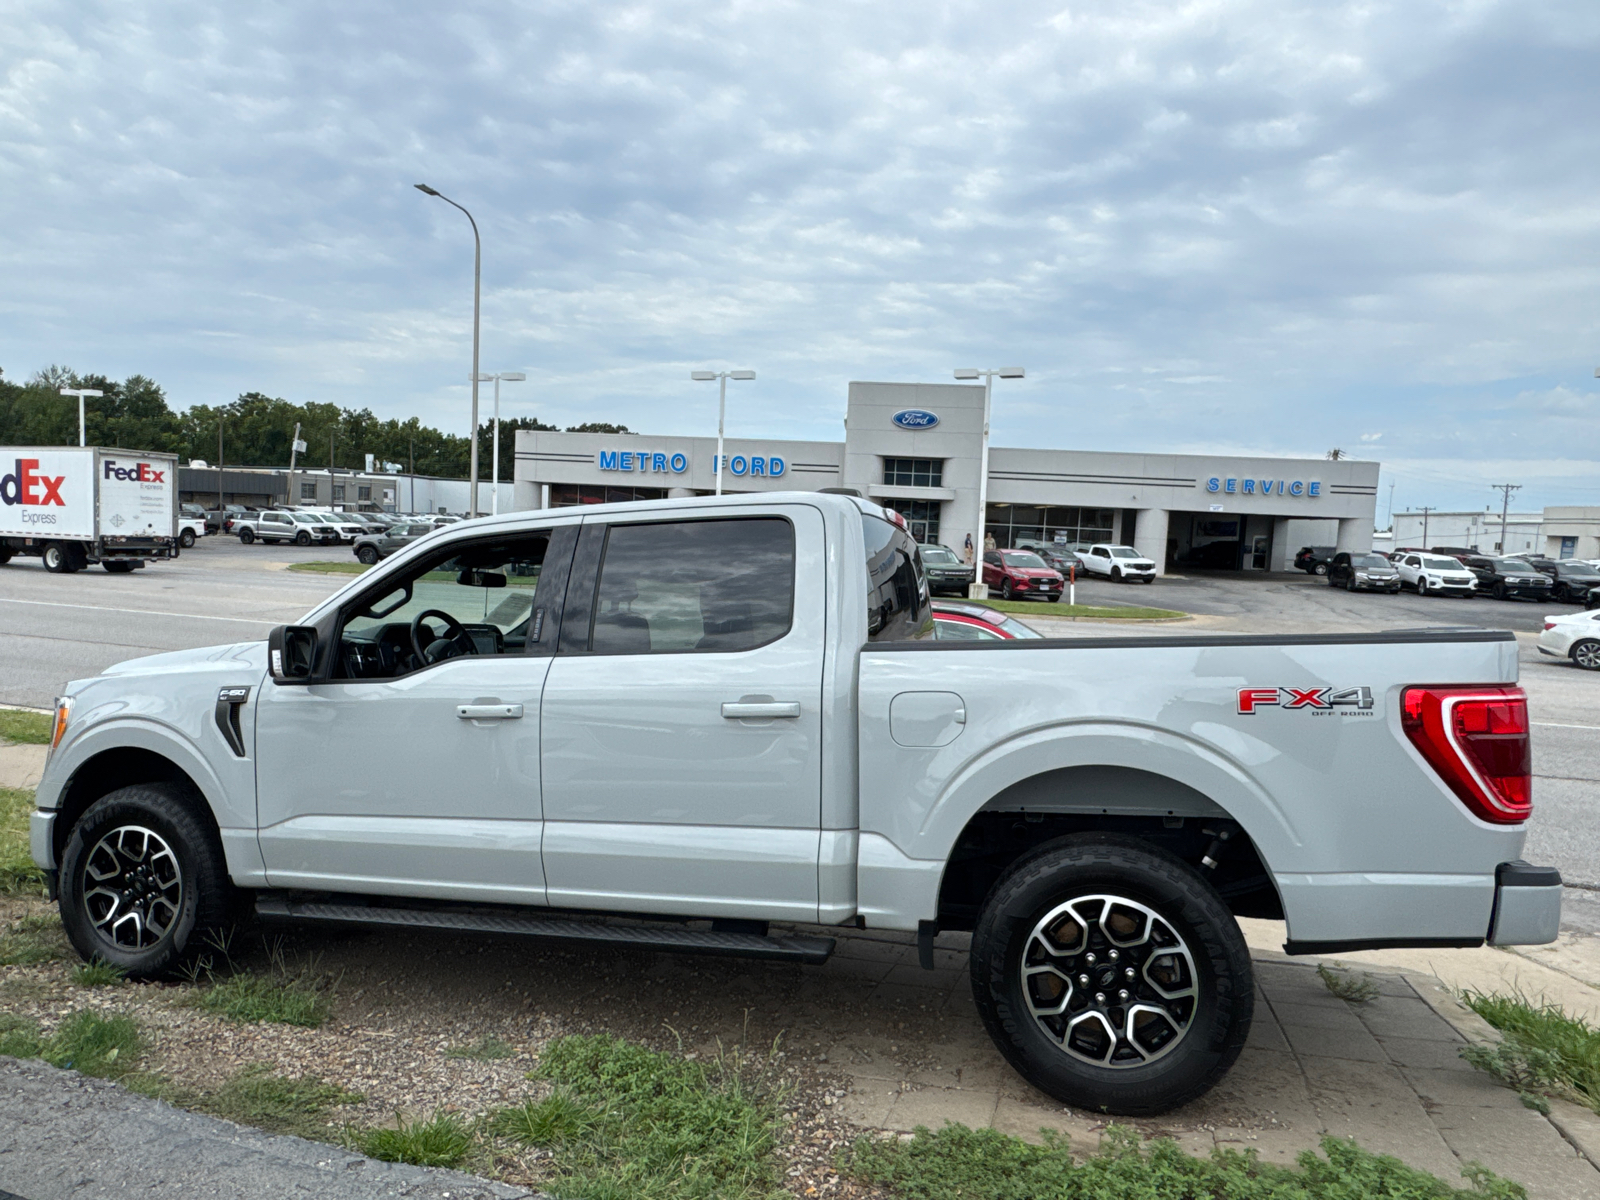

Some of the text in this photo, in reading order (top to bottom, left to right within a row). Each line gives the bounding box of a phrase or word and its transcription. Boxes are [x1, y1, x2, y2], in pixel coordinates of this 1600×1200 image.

[104, 460, 165, 483] FedEx
[598, 449, 787, 478] METRO FORD
[0, 458, 67, 506] dEx
[1206, 477, 1322, 497] SERVICE
[21, 509, 57, 526] Express
[1236, 687, 1374, 715] FX4
